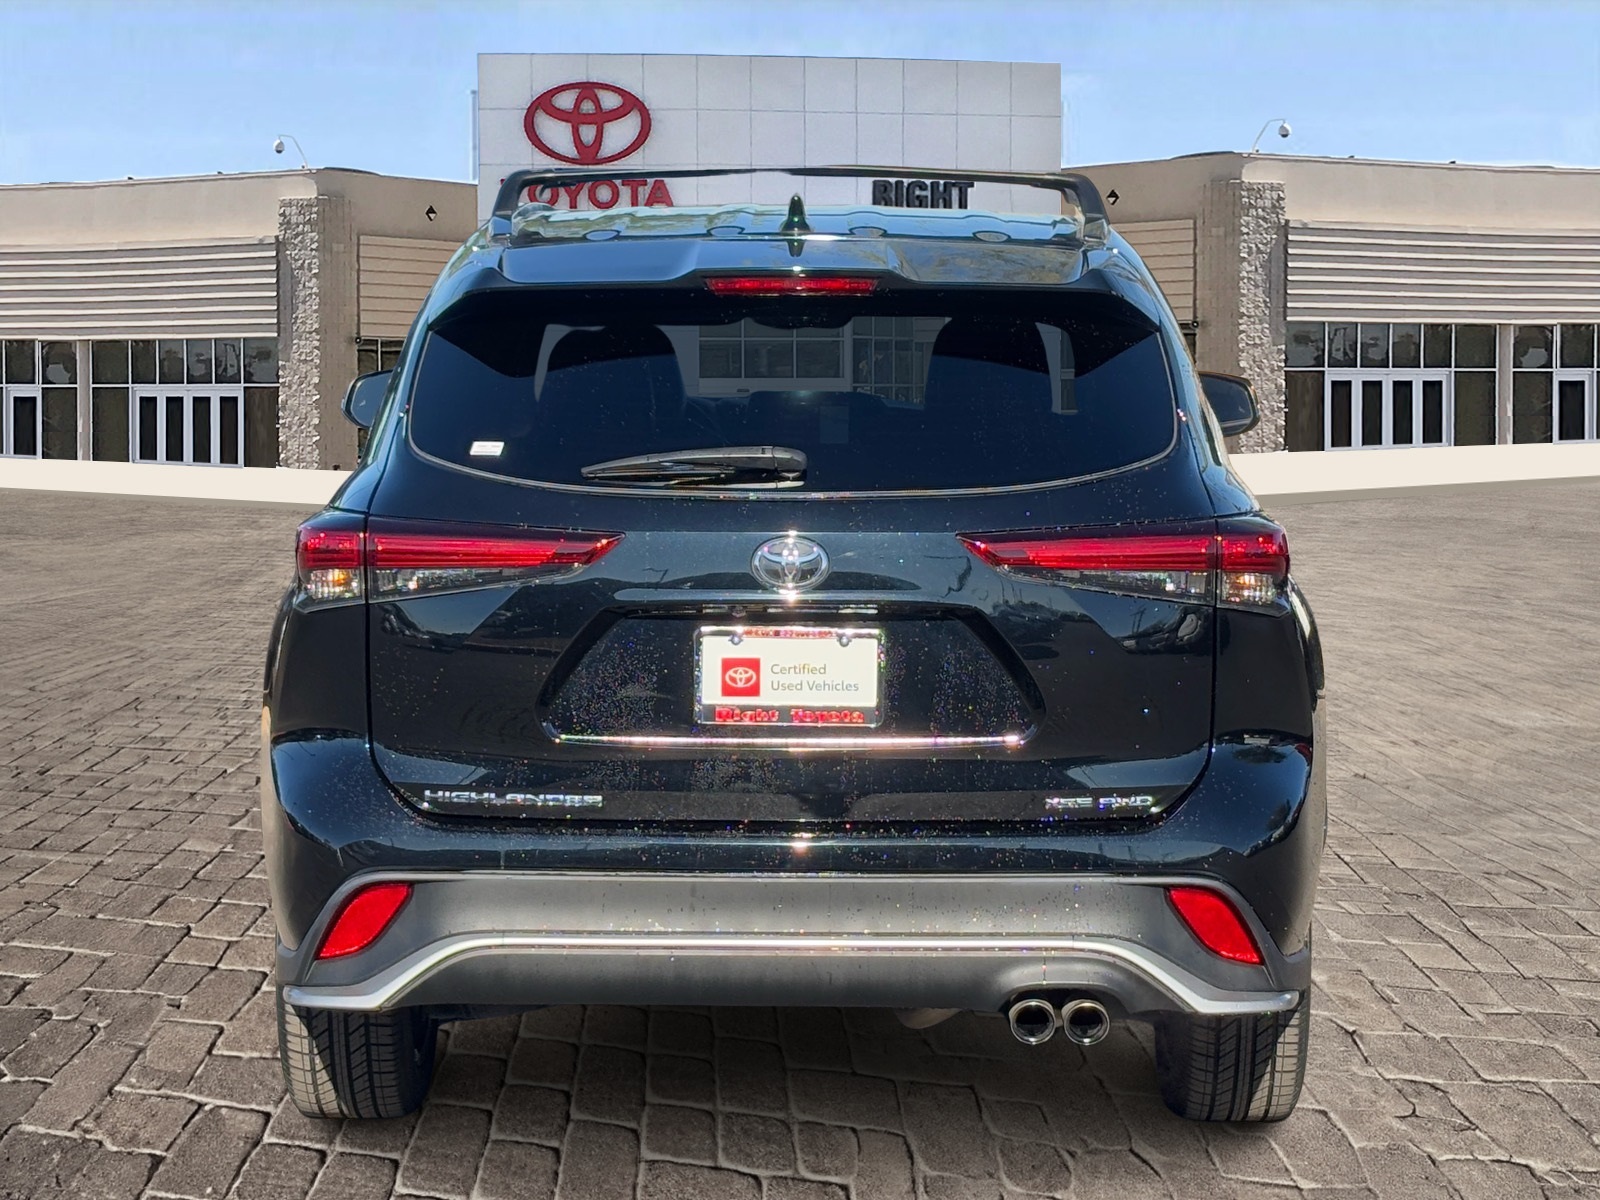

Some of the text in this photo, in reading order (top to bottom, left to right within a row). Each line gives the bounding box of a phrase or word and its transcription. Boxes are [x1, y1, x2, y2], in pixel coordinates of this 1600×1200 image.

[500, 179, 674, 209] OYOTA
[872, 180, 974, 209] RIGHT
[770, 663, 827, 675] Certified
[770, 680, 859, 692] Used Vehicles
[424, 789, 603, 806] HIGHLANDER
